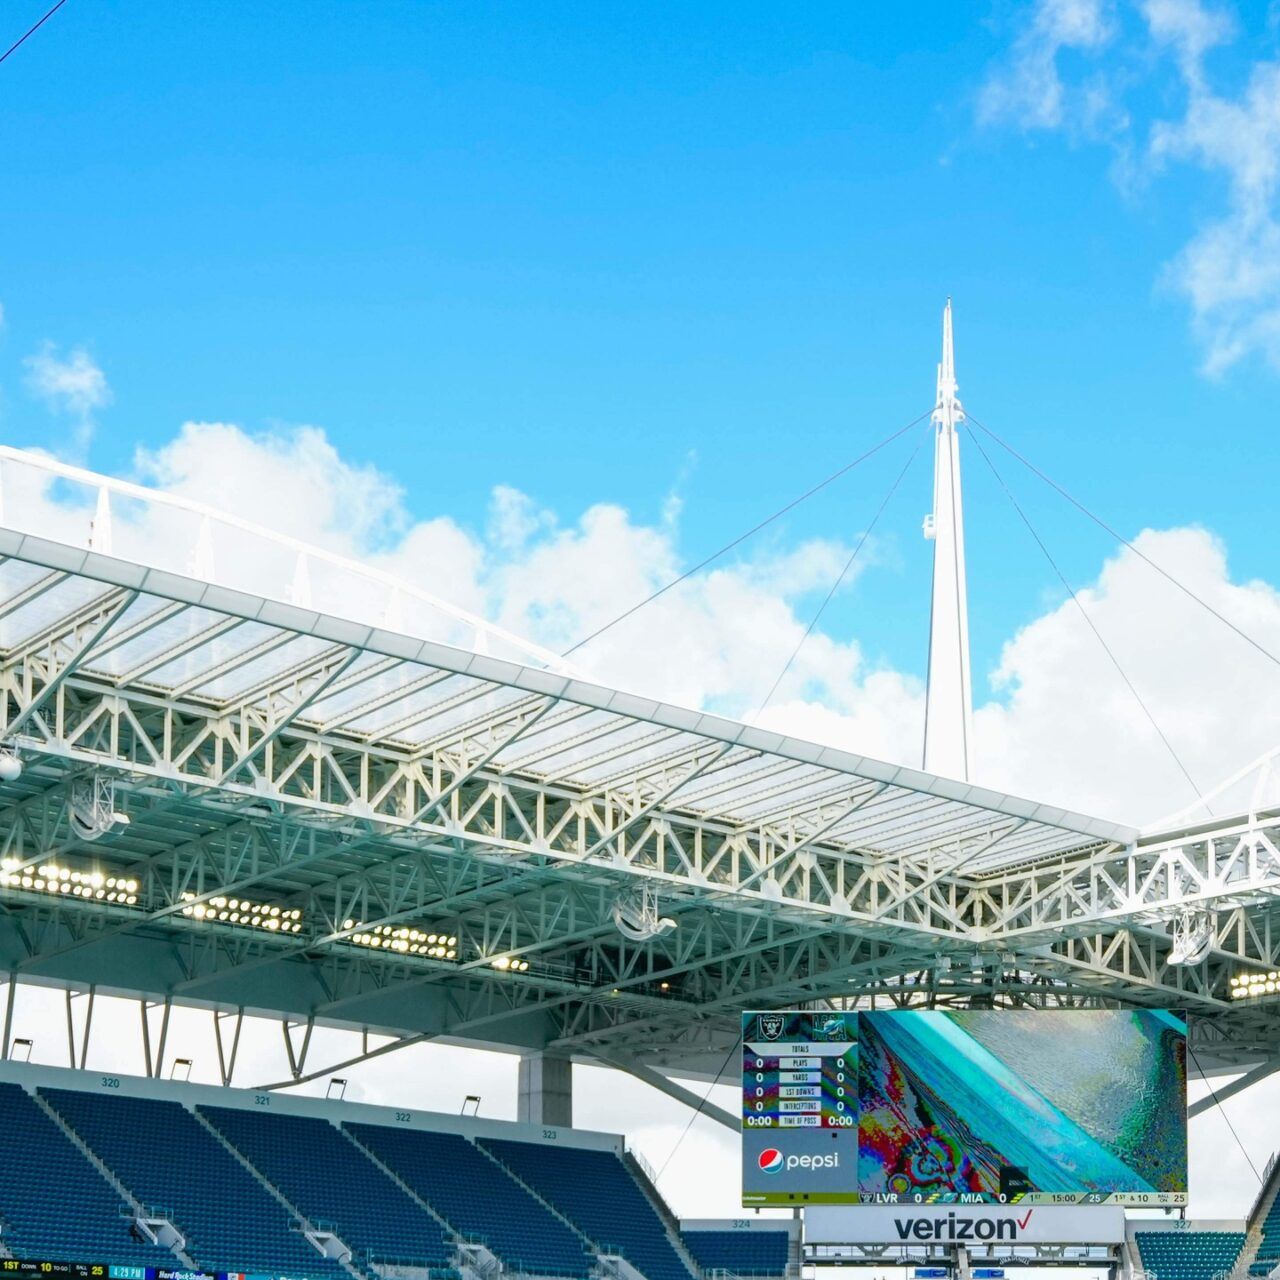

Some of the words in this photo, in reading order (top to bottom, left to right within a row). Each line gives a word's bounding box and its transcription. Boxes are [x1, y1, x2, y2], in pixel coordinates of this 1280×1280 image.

[756, 1058, 763, 1068] 0
[837, 1058, 844, 1068] 0
[756, 1073, 763, 1082] 0
[837, 1073, 844, 1082] 0
[102, 1077, 120, 1089] 320
[756, 1088, 763, 1097] 0
[837, 1088, 844, 1097] 0
[254, 1096, 270, 1106] 321
[756, 1102, 763, 1111] 0
[837, 1102, 844, 1111] 0
[395, 1112, 411, 1122] 322
[748, 1116, 771, 1126] 0:00
[829, 1116, 853, 1126] 0:00
[542, 1130, 557, 1140] 323
[787, 1153, 839, 1171] pepsi
[876, 1194, 898, 1203] LVR
[915, 1194, 922, 1203] 0
[961, 1194, 984, 1203] MIA
[1000, 1194, 1007, 1203] 0
[1052, 1194, 1076, 1203] 15:00
[1090, 1194, 1101, 1203] 25
[1138, 1194, 1149, 1202] 10
[1174, 1194, 1185, 1203] 25
[732, 1220, 750, 1229] 324
[894, 1212, 1017, 1240] verizon
[1174, 1220, 1193, 1229] 327
[4, 1261, 19, 1270] 1ST
[41, 1262, 52, 1272] 10
[91, 1266, 103, 1276] 25
